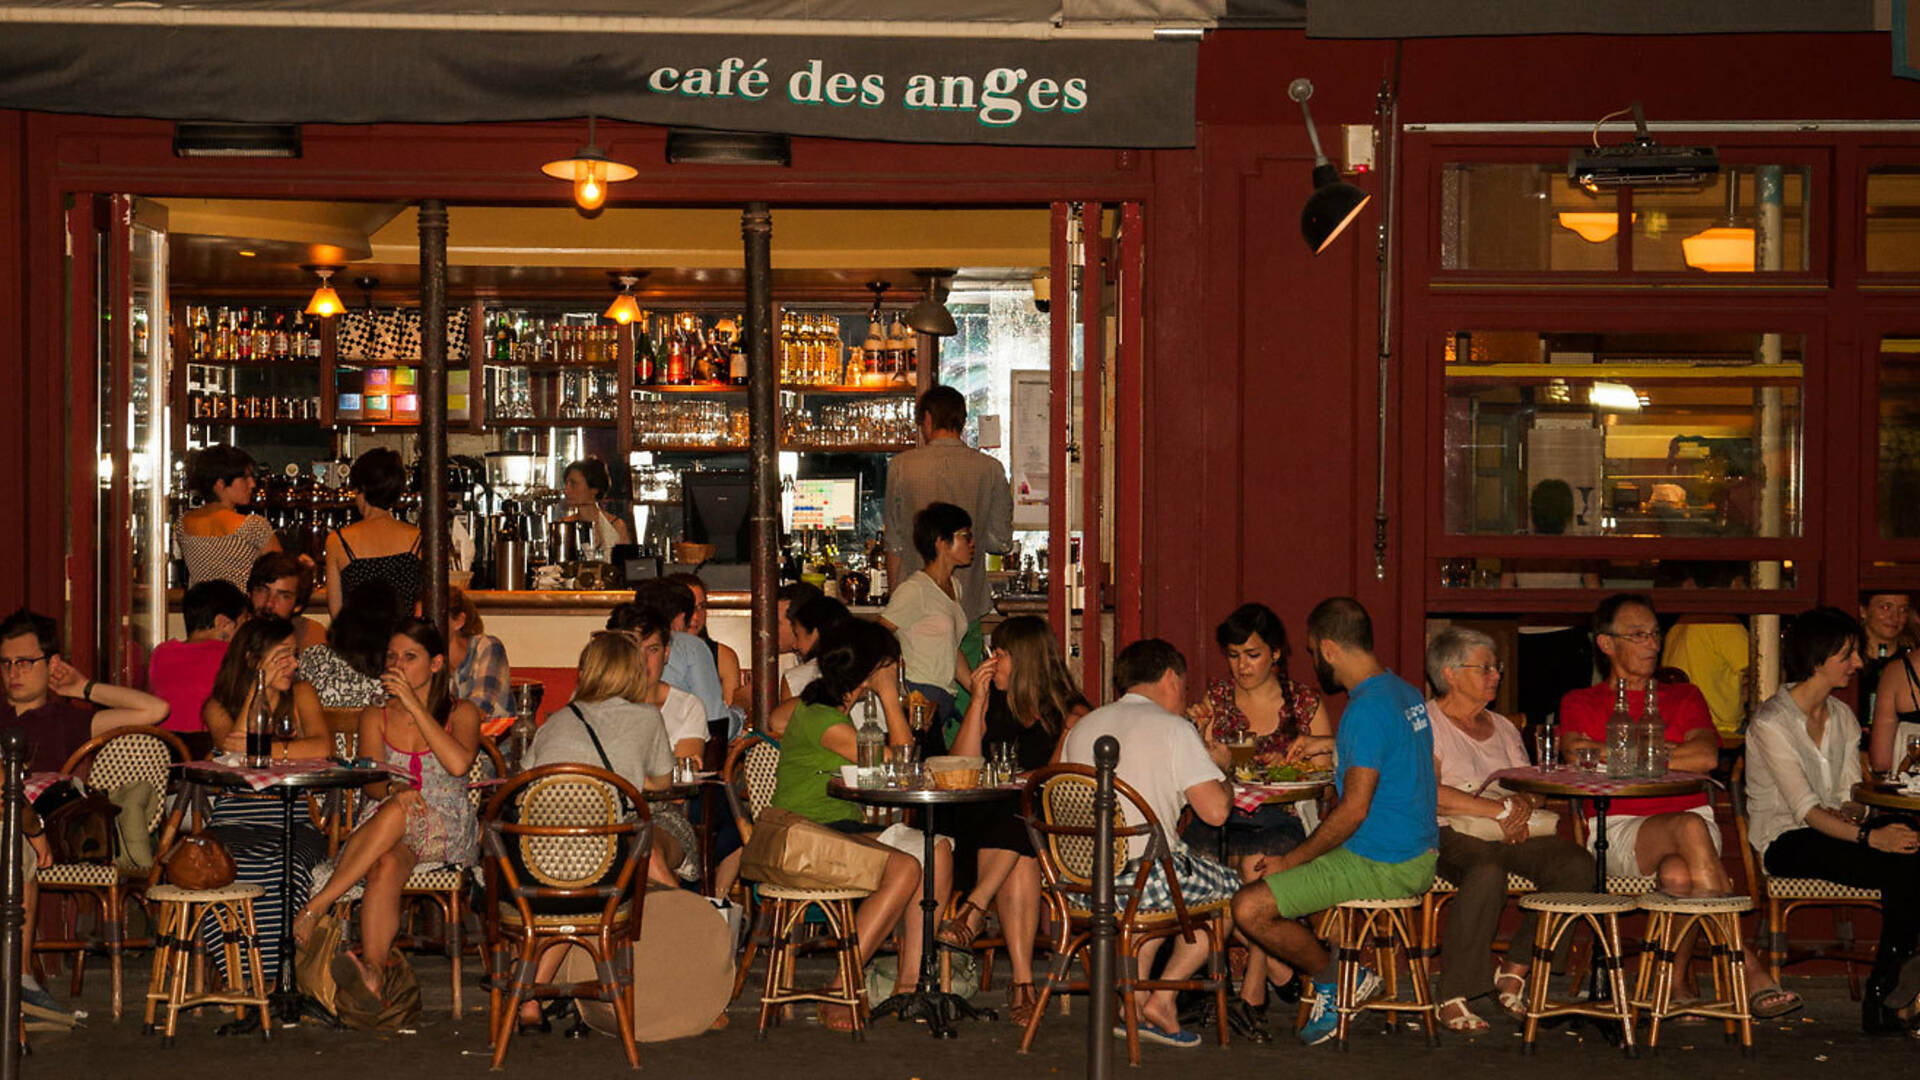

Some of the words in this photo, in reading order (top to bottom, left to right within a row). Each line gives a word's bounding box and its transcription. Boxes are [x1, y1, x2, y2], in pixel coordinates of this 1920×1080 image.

[648, 57, 769, 100] café
[787, 59, 885, 108] des
[902, 68, 1088, 128] anges
